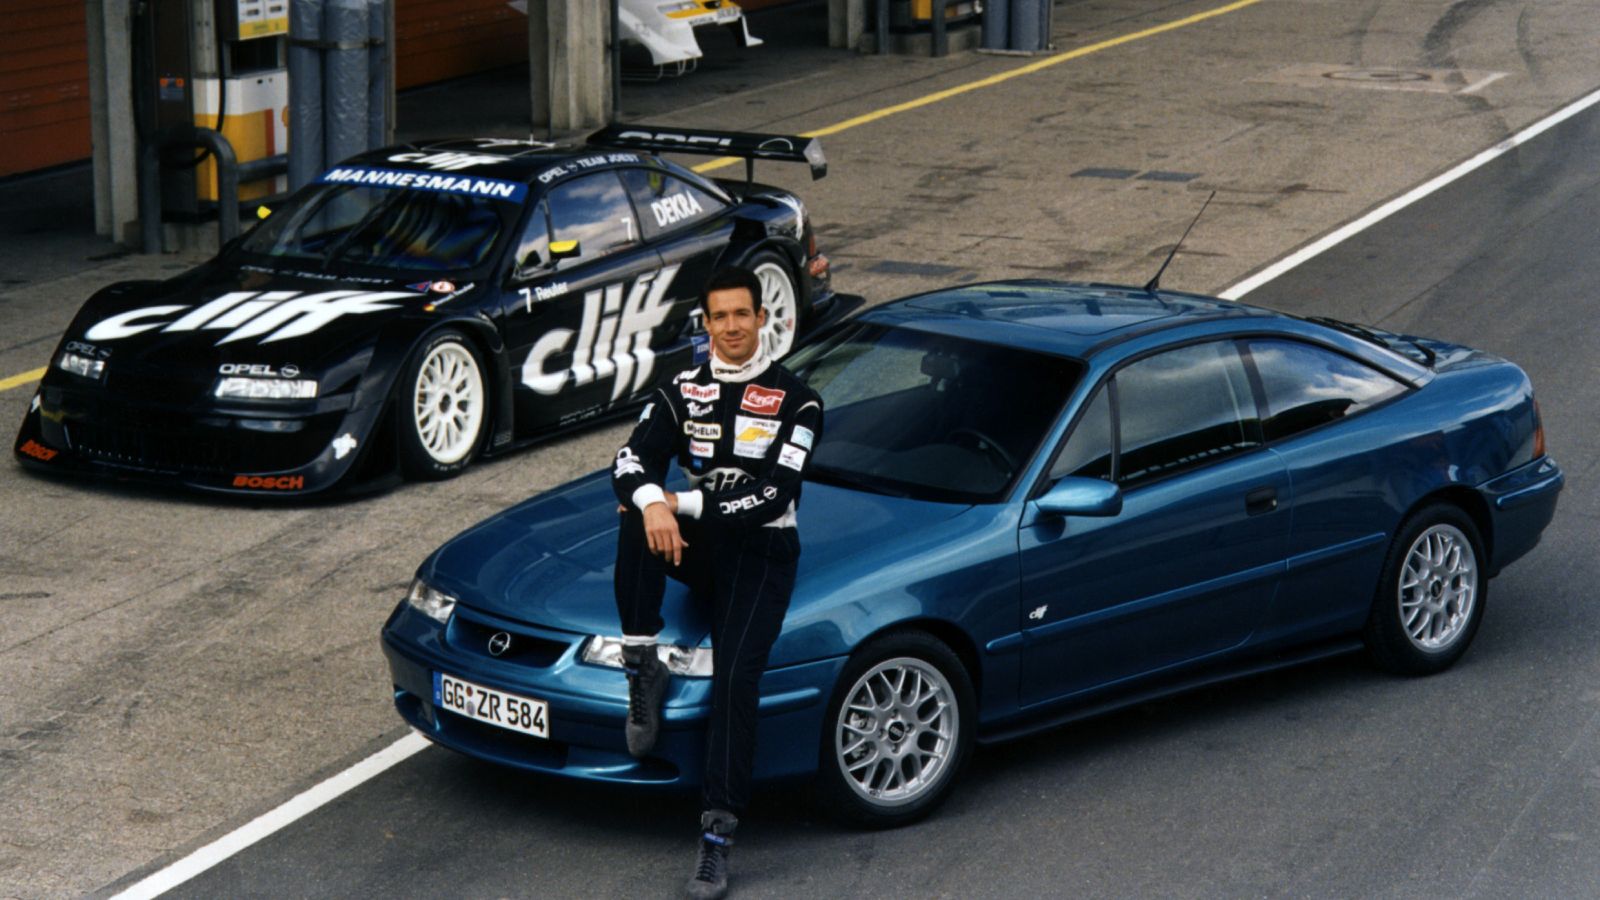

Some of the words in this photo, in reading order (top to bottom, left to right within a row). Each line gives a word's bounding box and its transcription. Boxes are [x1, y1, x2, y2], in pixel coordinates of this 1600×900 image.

[324, 168, 516, 198] MANNESMANN
[538, 165, 568, 185] OPEL
[576, 154, 607, 169] TEAM
[607, 153, 640, 164] JOEST
[650, 190, 704, 228] DEKRA
[620, 217, 634, 241] 7
[518, 287, 532, 313] 7
[534, 281, 569, 302] Reuter
[84, 289, 428, 346] cliff
[521, 263, 683, 410] cliff
[218, 363, 277, 376] OPEL
[233, 475, 304, 490] BOSCH
[719, 494, 765, 514] OPEL
[443, 679, 465, 710] GG
[476, 689, 501, 720] ZR
[507, 698, 546, 734] 584
